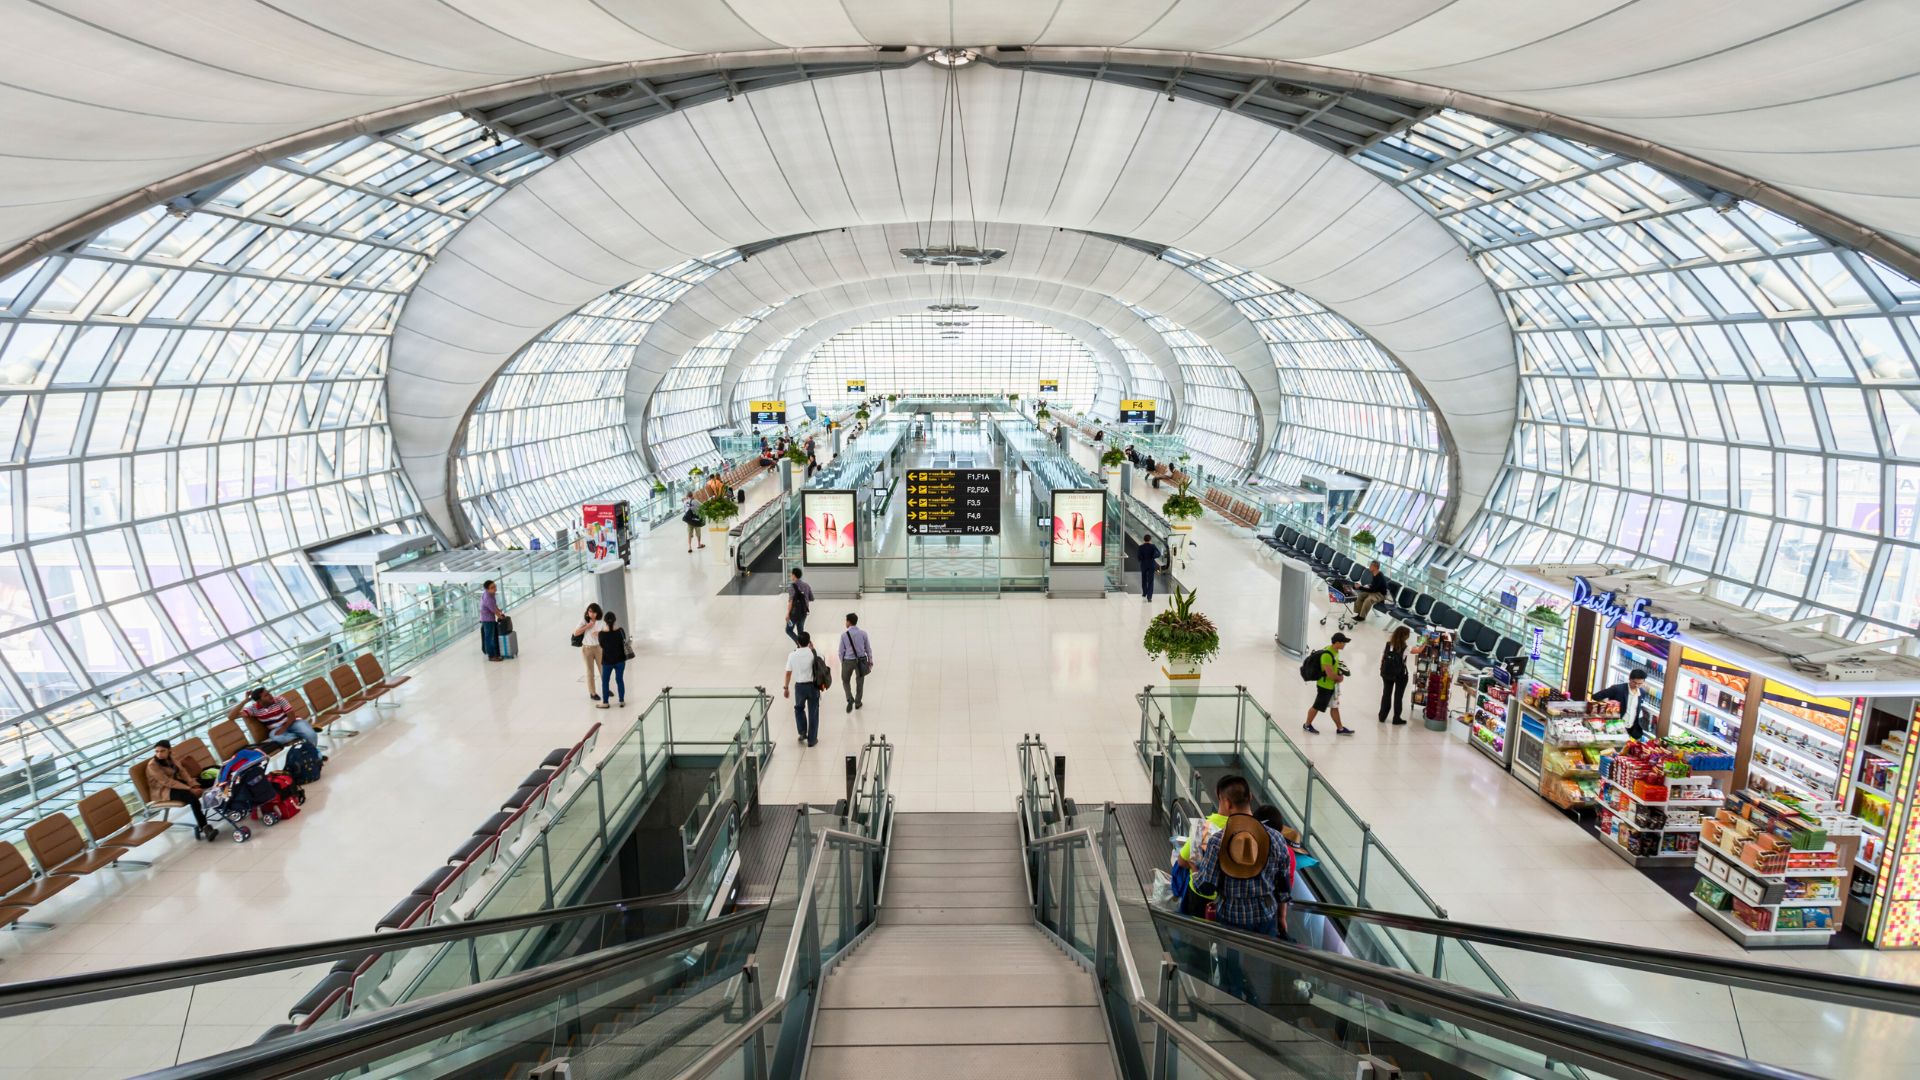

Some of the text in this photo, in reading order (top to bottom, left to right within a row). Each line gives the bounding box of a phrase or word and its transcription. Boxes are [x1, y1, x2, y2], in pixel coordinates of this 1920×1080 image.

[761, 402, 773, 411] F3
[967, 473, 990, 481] F1,F1A
[967, 486, 990, 494] F2,F2A
[967, 499, 981, 507] F3,5
[967, 525, 994, 533] F1A,F2A
[1573, 576, 1679, 639] Duty Free
